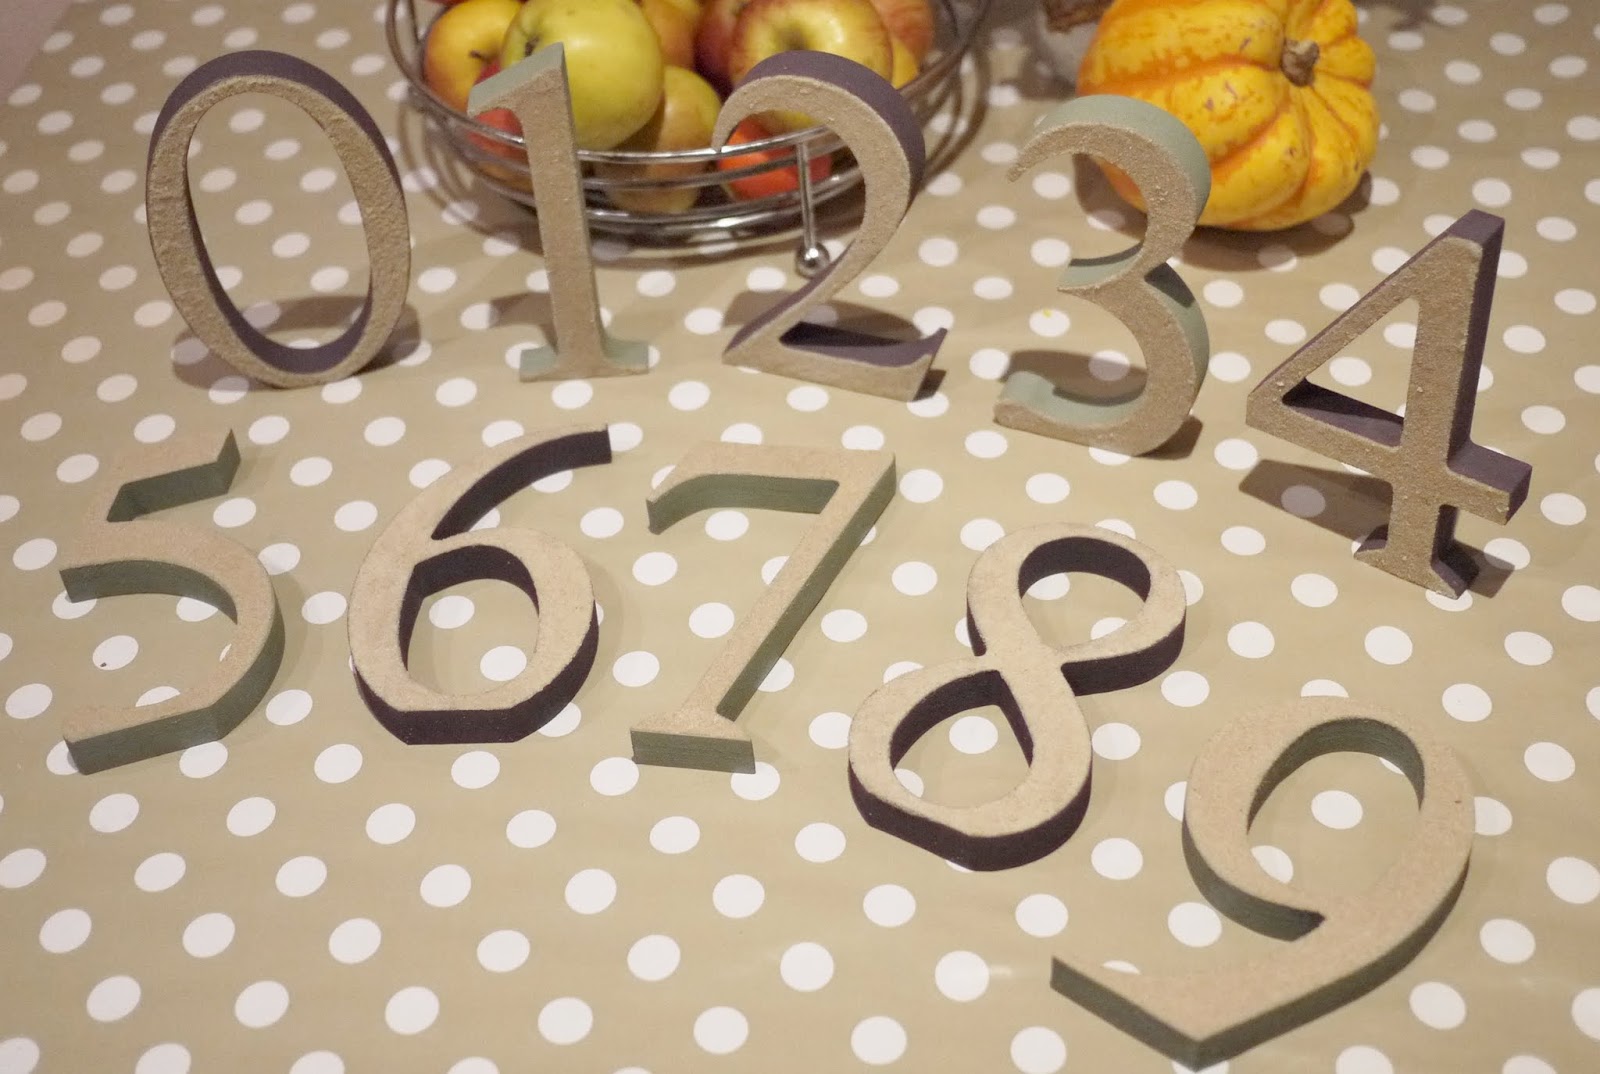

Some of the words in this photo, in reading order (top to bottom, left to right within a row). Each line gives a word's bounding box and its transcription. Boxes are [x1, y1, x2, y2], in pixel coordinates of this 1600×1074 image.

[147, 50, 410, 388] 0
[468, 43, 649, 381] 1
[711, 51, 947, 400] 2
[995, 94, 1211, 456] 3
[1247, 209, 1532, 599] 4
[60, 429, 284, 775] 5
[349, 424, 611, 744] 6
[630, 442, 896, 773] 7
[849, 524, 1186, 871] 8
[1051, 697, 1473, 1070] 9
